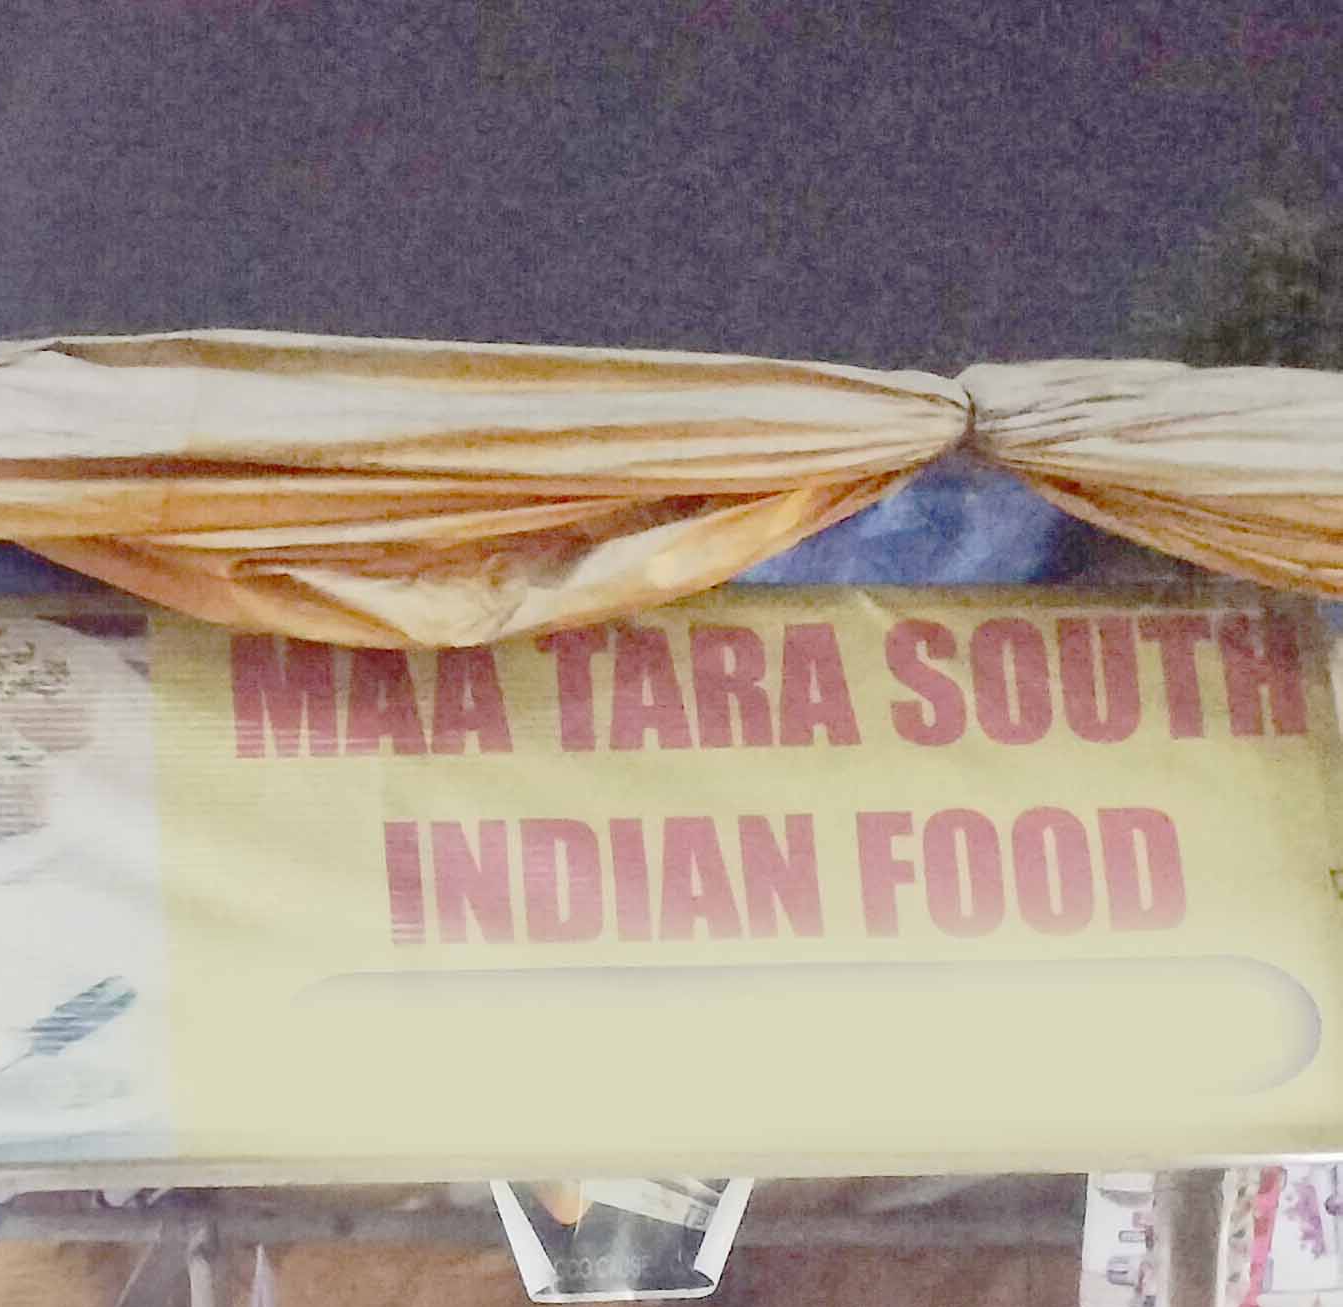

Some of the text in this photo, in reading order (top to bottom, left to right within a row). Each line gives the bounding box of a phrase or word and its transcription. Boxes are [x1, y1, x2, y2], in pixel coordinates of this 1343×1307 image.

[231, 612, 1308, 758] MAA TARA SOUTH
[383, 806, 1187, 946] INDIAN FOOD
